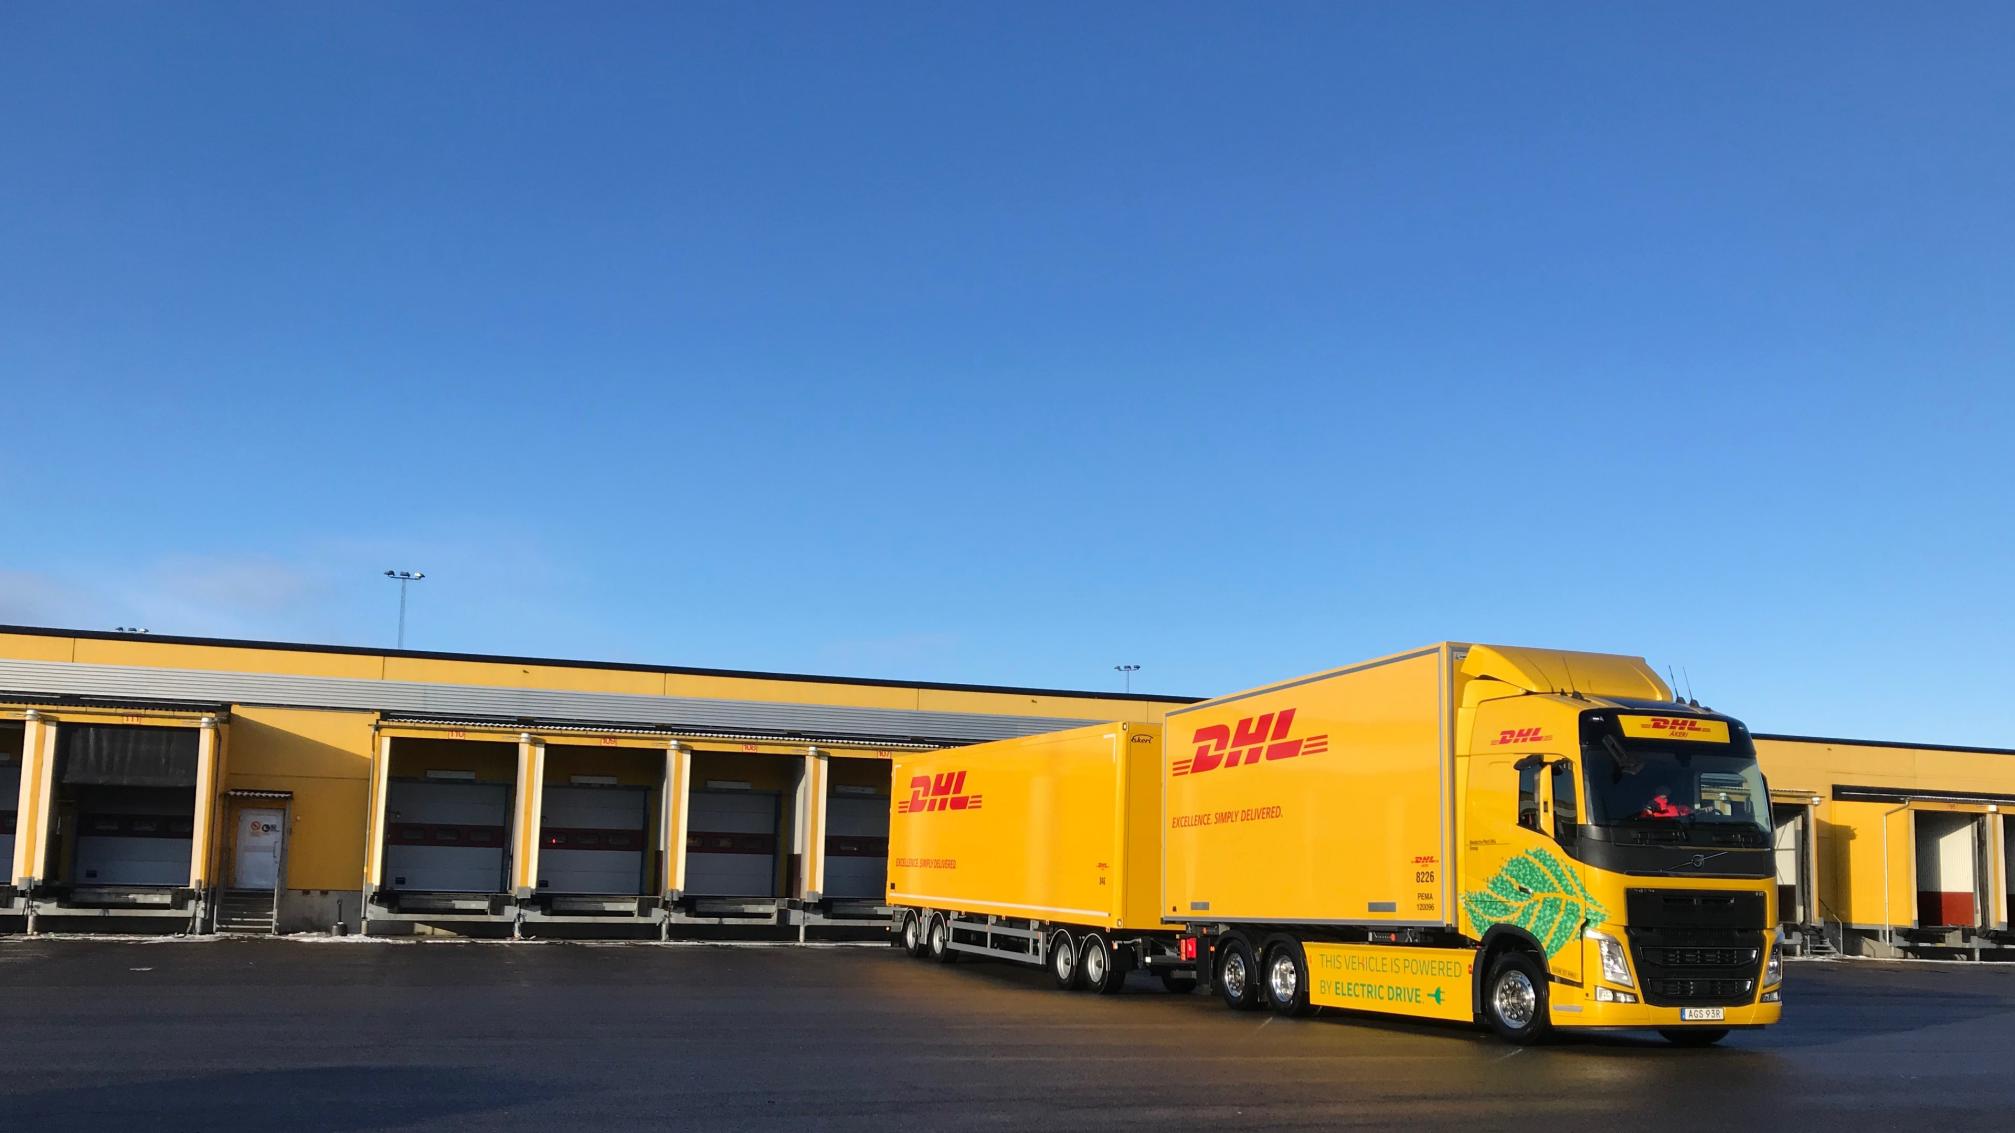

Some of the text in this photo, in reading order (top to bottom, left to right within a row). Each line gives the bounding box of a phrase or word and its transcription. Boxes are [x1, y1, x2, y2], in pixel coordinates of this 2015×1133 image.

[1650, 718, 1702, 732] DHL
[1190, 708, 1304, 774] DHL
[1499, 728, 1543, 744] DHL
[908, 771, 969, 812] DHL
[1172, 805, 1284, 828] EXCELLENCE. SIMPLY DELIVERED.
[1415, 871, 1435, 883] 8226
[1417, 893, 1434, 901] PEMA
[1320, 953, 1463, 978] THIS VEHICLE IS POWERED
[1319, 979, 1425, 1005] BY ELECTRIC DRIVE.
[1688, 1009, 1721, 1019] AGS 93R
